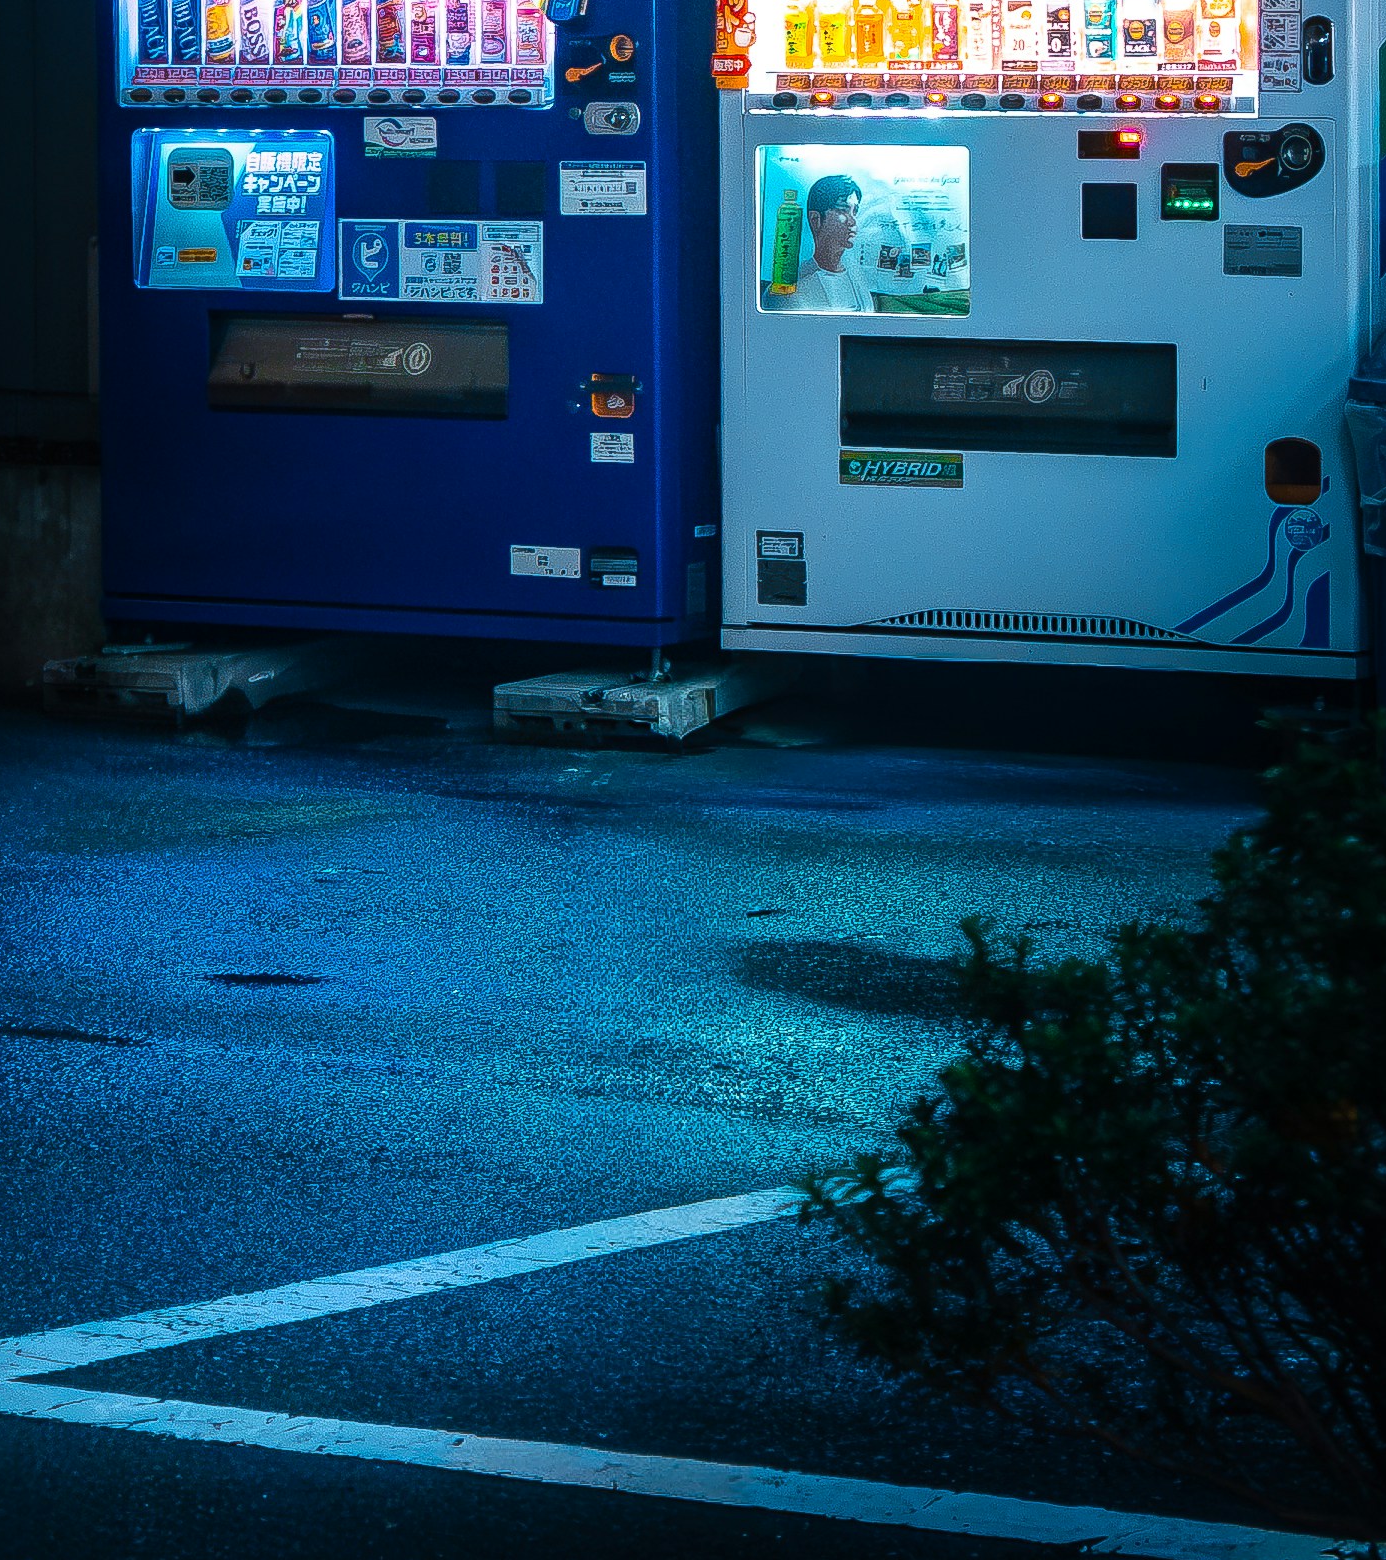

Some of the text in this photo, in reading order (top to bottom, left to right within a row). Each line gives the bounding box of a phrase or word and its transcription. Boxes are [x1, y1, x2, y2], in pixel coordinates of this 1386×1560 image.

[243, 6, 265, 61] BOSS
[242, 172, 321, 194] キャンペーン
[862, 460, 942, 481] HYBRID
